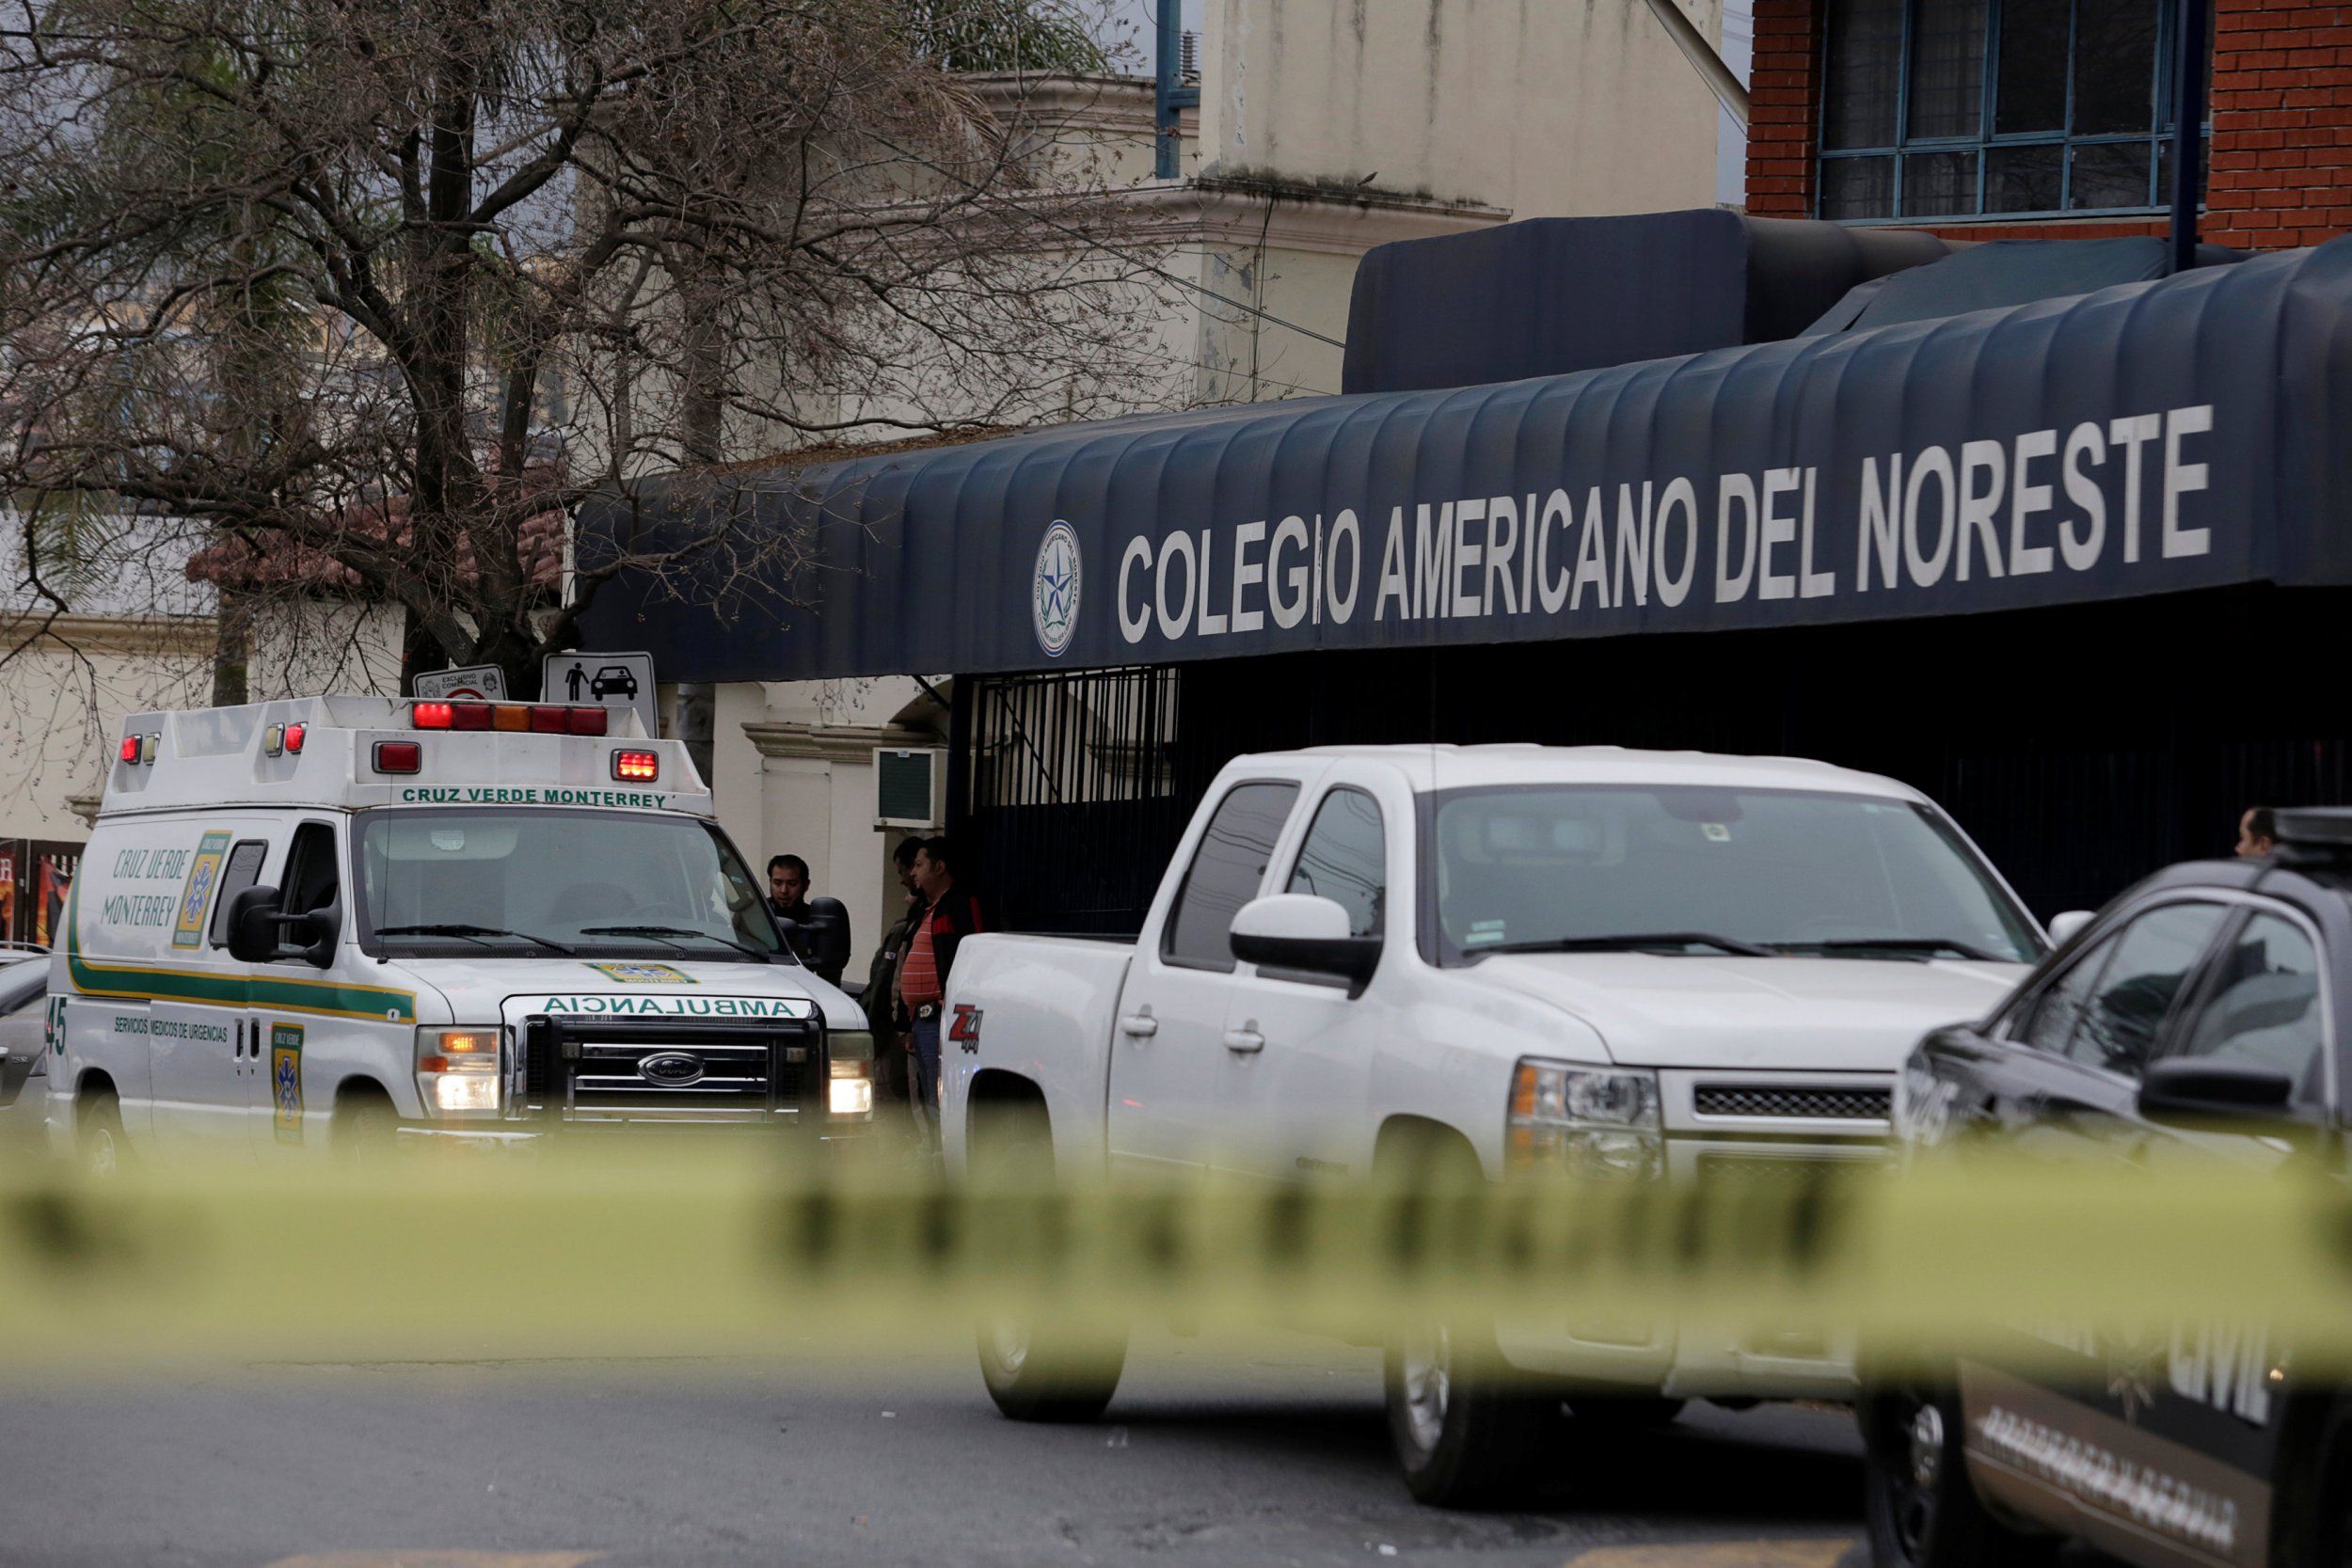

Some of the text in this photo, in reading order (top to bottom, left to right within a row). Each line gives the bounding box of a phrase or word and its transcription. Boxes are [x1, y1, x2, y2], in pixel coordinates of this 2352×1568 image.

[1118, 404, 2214, 644] COLEGIO AMERICANO DEL NORESTE
[441, 673, 477, 683] EXCLUSIVO
[403, 788, 667, 809] CRUZ VERDE MONTERREY
[113, 849, 190, 879] CRUZ VERDE
[100, 895, 177, 927] MONTERREY
[46, 996, 68, 1055] 45
[114, 1016, 228, 1043] SERVICIOS MEDICOS DE URGENCIAS
[948, 1003, 984, 1042] Z71
